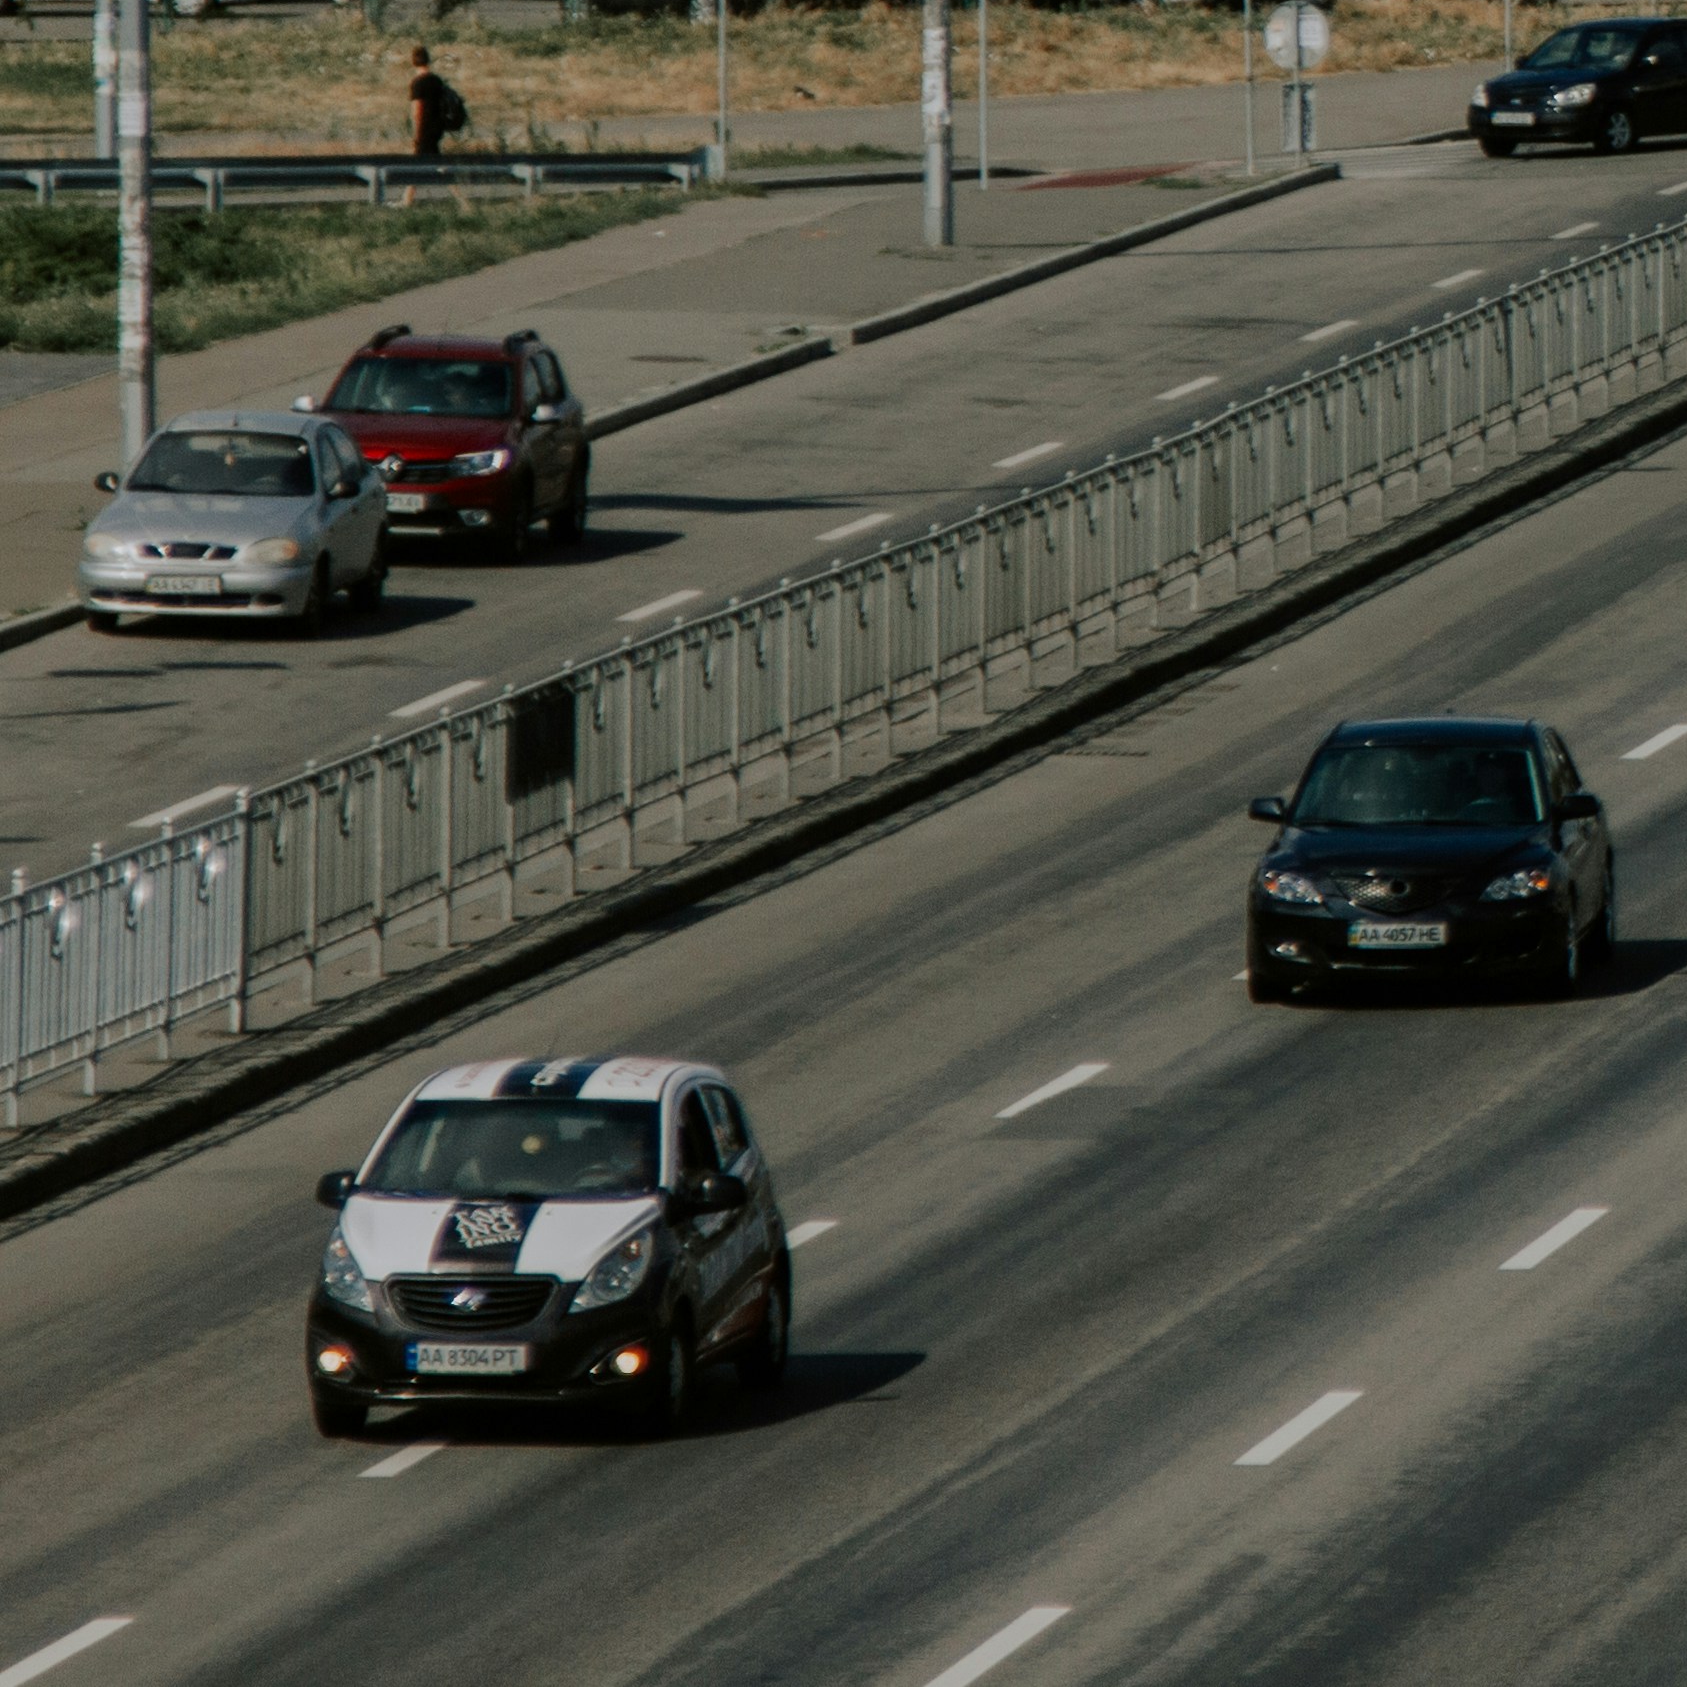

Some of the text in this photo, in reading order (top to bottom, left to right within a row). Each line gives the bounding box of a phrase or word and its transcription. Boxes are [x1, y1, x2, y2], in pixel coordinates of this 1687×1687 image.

[1359, 928, 1380, 941] AA
[1418, 928, 1440, 942] HE
[420, 1348, 519, 1367] AA 8304 PT
